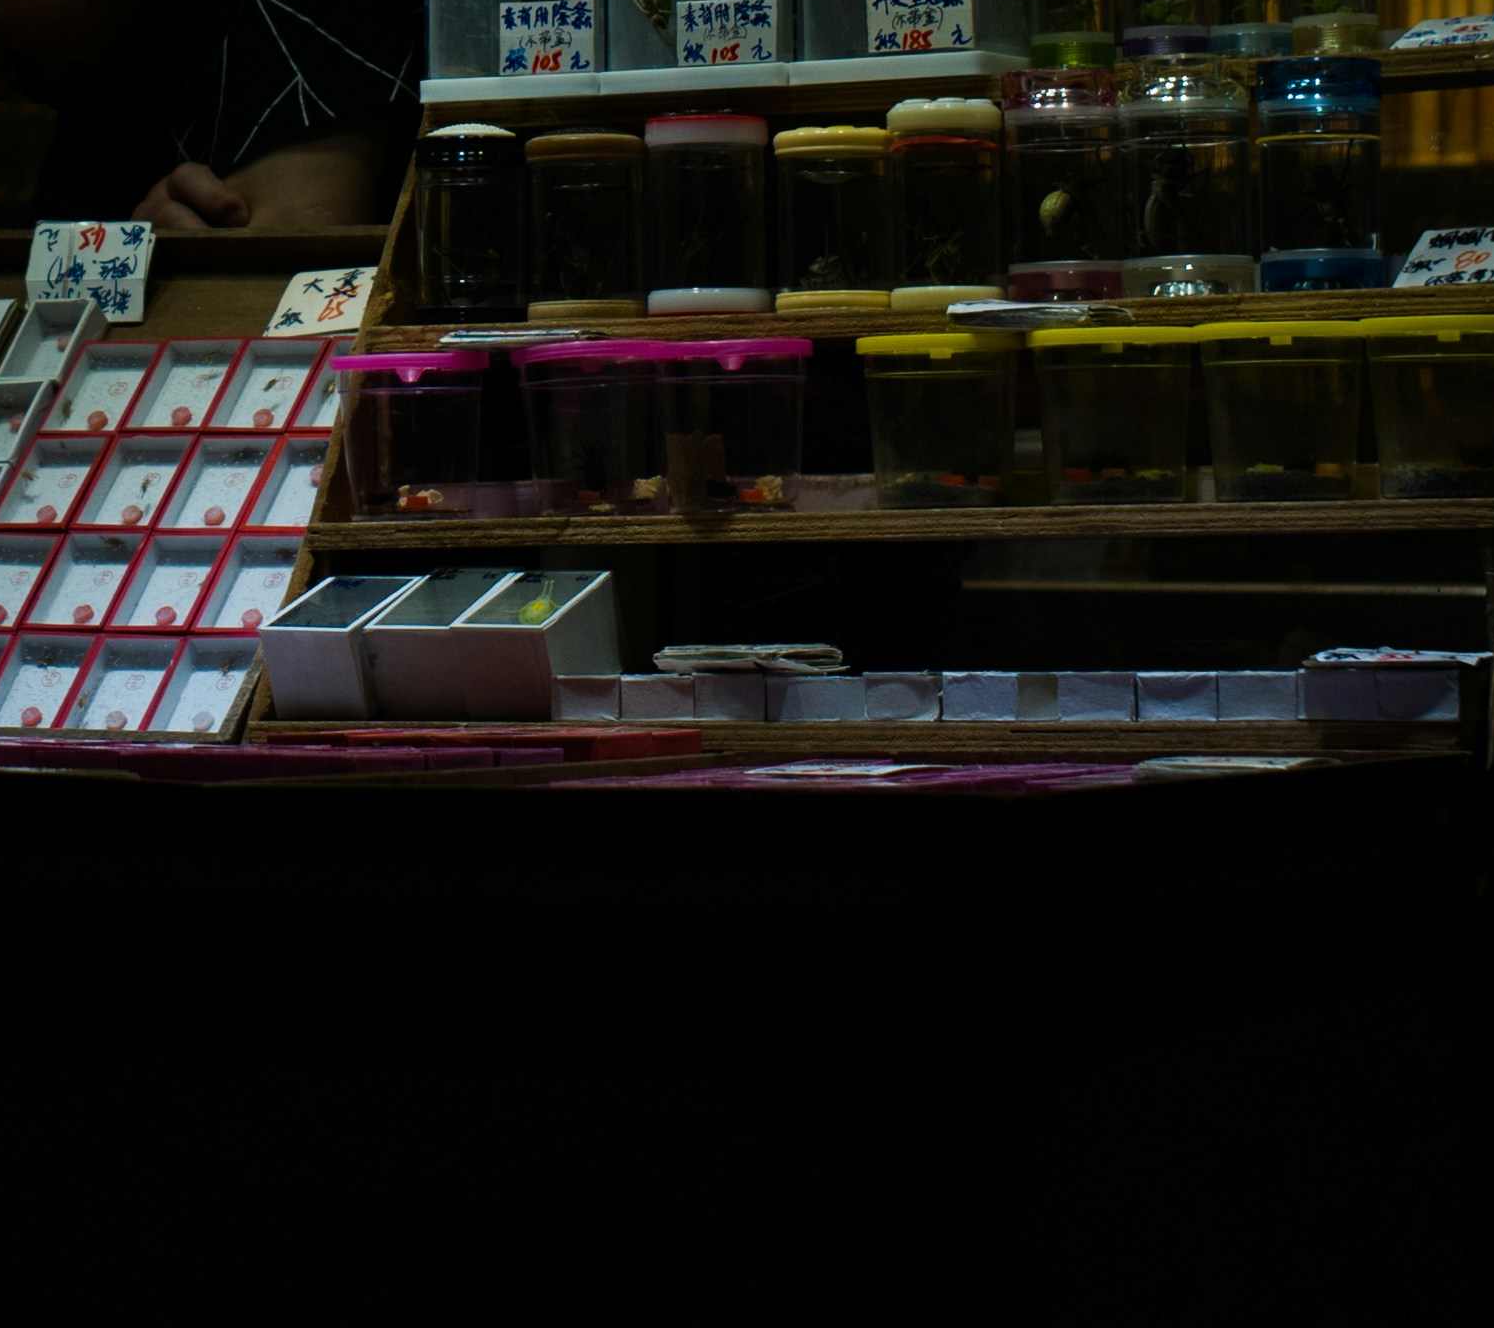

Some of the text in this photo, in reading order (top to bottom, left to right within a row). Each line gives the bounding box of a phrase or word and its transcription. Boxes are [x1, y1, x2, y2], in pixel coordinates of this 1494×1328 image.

[901, 28, 934, 51] 185
[531, 47, 564, 75] 105
[711, 42, 742, 66] 105
[1454, 250, 1492, 271] 80
